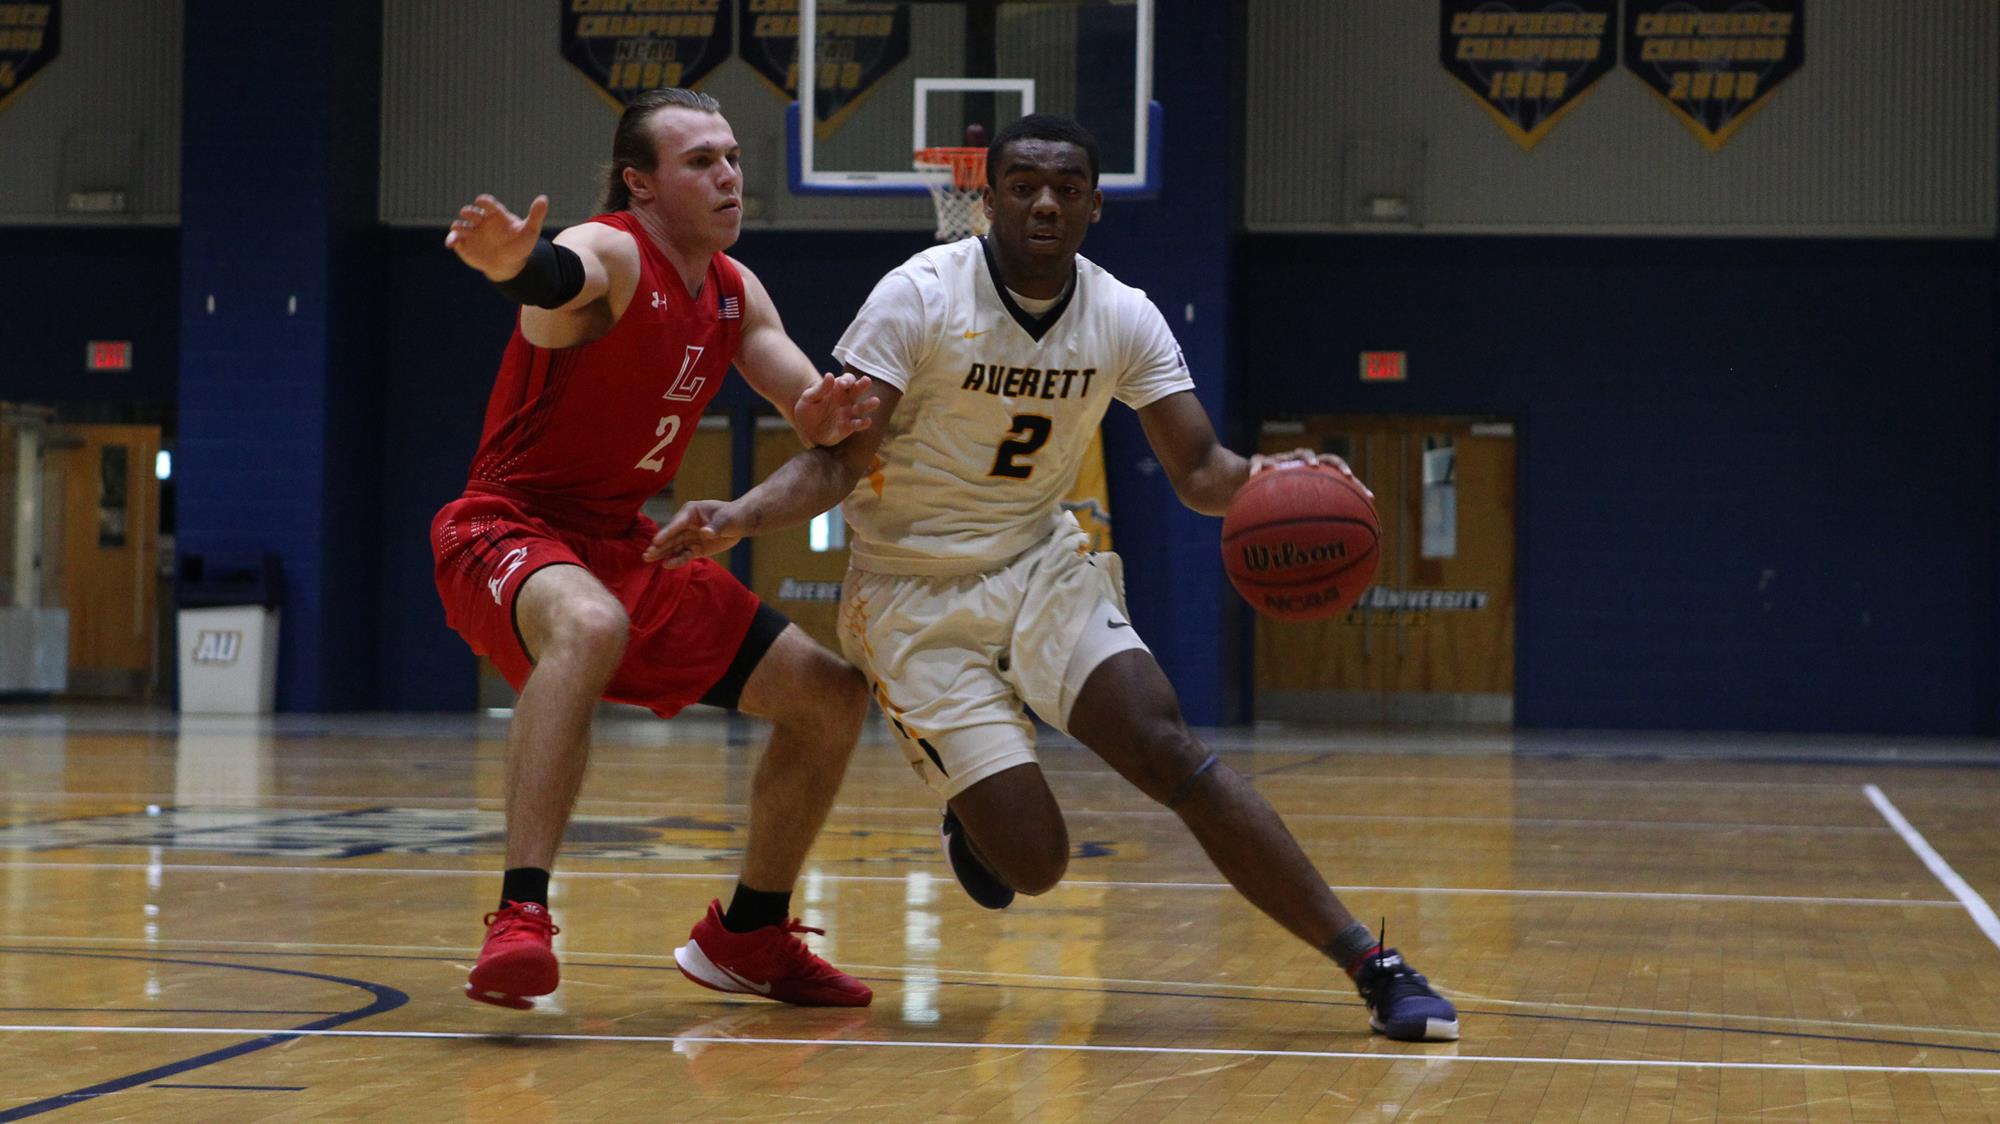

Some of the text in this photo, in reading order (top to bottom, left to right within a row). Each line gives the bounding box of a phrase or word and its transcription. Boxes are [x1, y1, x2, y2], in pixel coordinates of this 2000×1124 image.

[577, 15, 717, 37] CHAMPIONS
[754, 15, 894, 37] CHAPIONS
[1451, 12, 1608, 35] CONFERENCE
[1635, 12, 1794, 36] CONFERENCE
[1456, 38, 1601, 60] CHAMPIONS
[1641, 38, 1787, 61] CHAMPIONS
[95, 342, 126, 368] EXIT
[1367, 352, 1400, 379] EXIT
[662, 345, 706, 401] L
[961, 363, 1097, 400] AVERETT
[633, 414, 681, 473] 2
[988, 414, 1054, 481] 2
[1243, 541, 1347, 572] Wilson
[195, 631, 241, 663] AU
